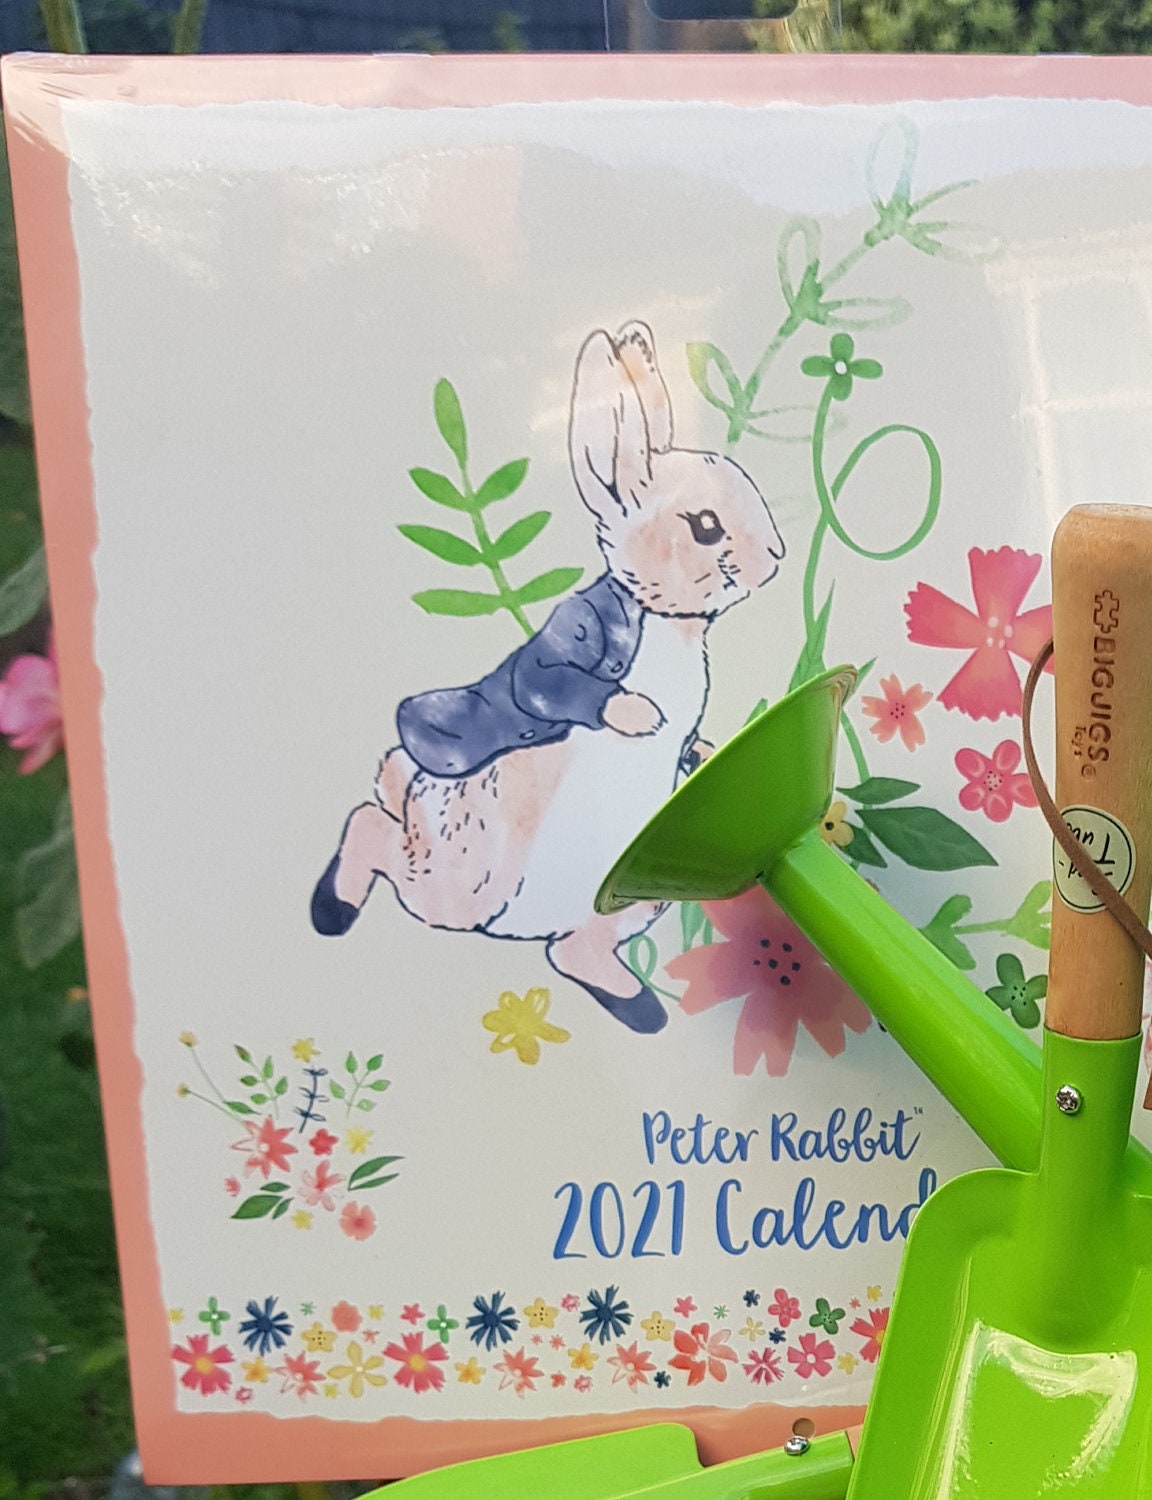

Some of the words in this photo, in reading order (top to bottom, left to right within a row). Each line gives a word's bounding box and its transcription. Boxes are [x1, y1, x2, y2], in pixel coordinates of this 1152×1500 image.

[1088, 636, 1116, 763] BIGJIGS
[643, 1110, 759, 1165] Peter
[553, 1179, 686, 1260] 2021
